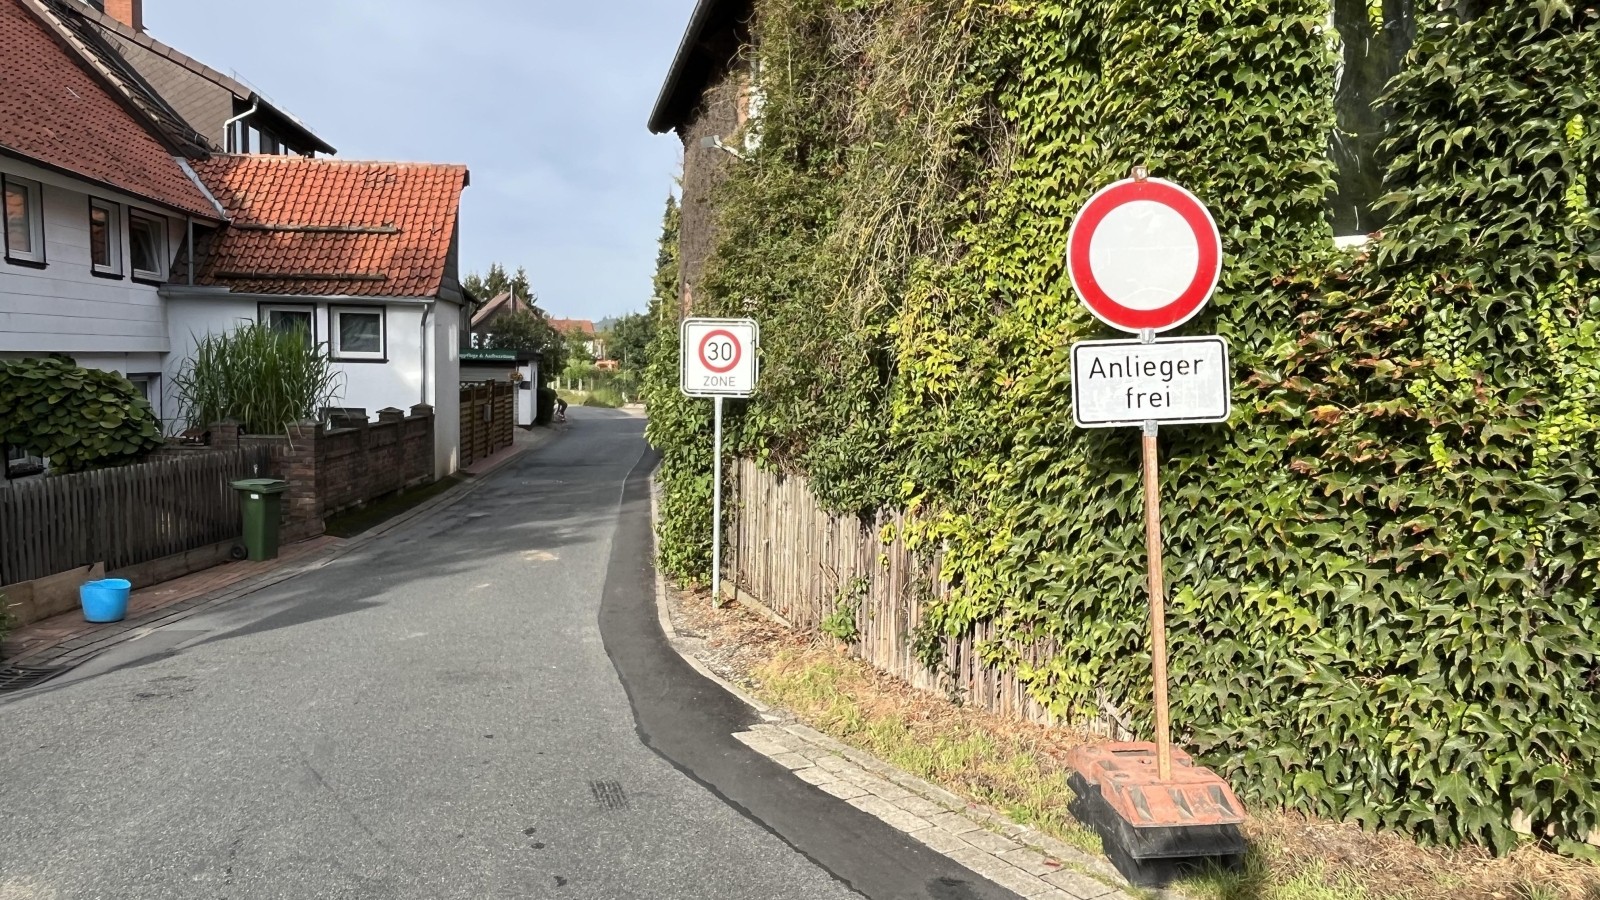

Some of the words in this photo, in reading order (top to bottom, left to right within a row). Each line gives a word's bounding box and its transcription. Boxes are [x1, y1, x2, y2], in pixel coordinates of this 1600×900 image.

[708, 342, 732, 361] 30
[1089, 355, 1204, 382] Anlieger
[703, 376, 736, 387] ZONE
[1125, 385, 1171, 409] frei
